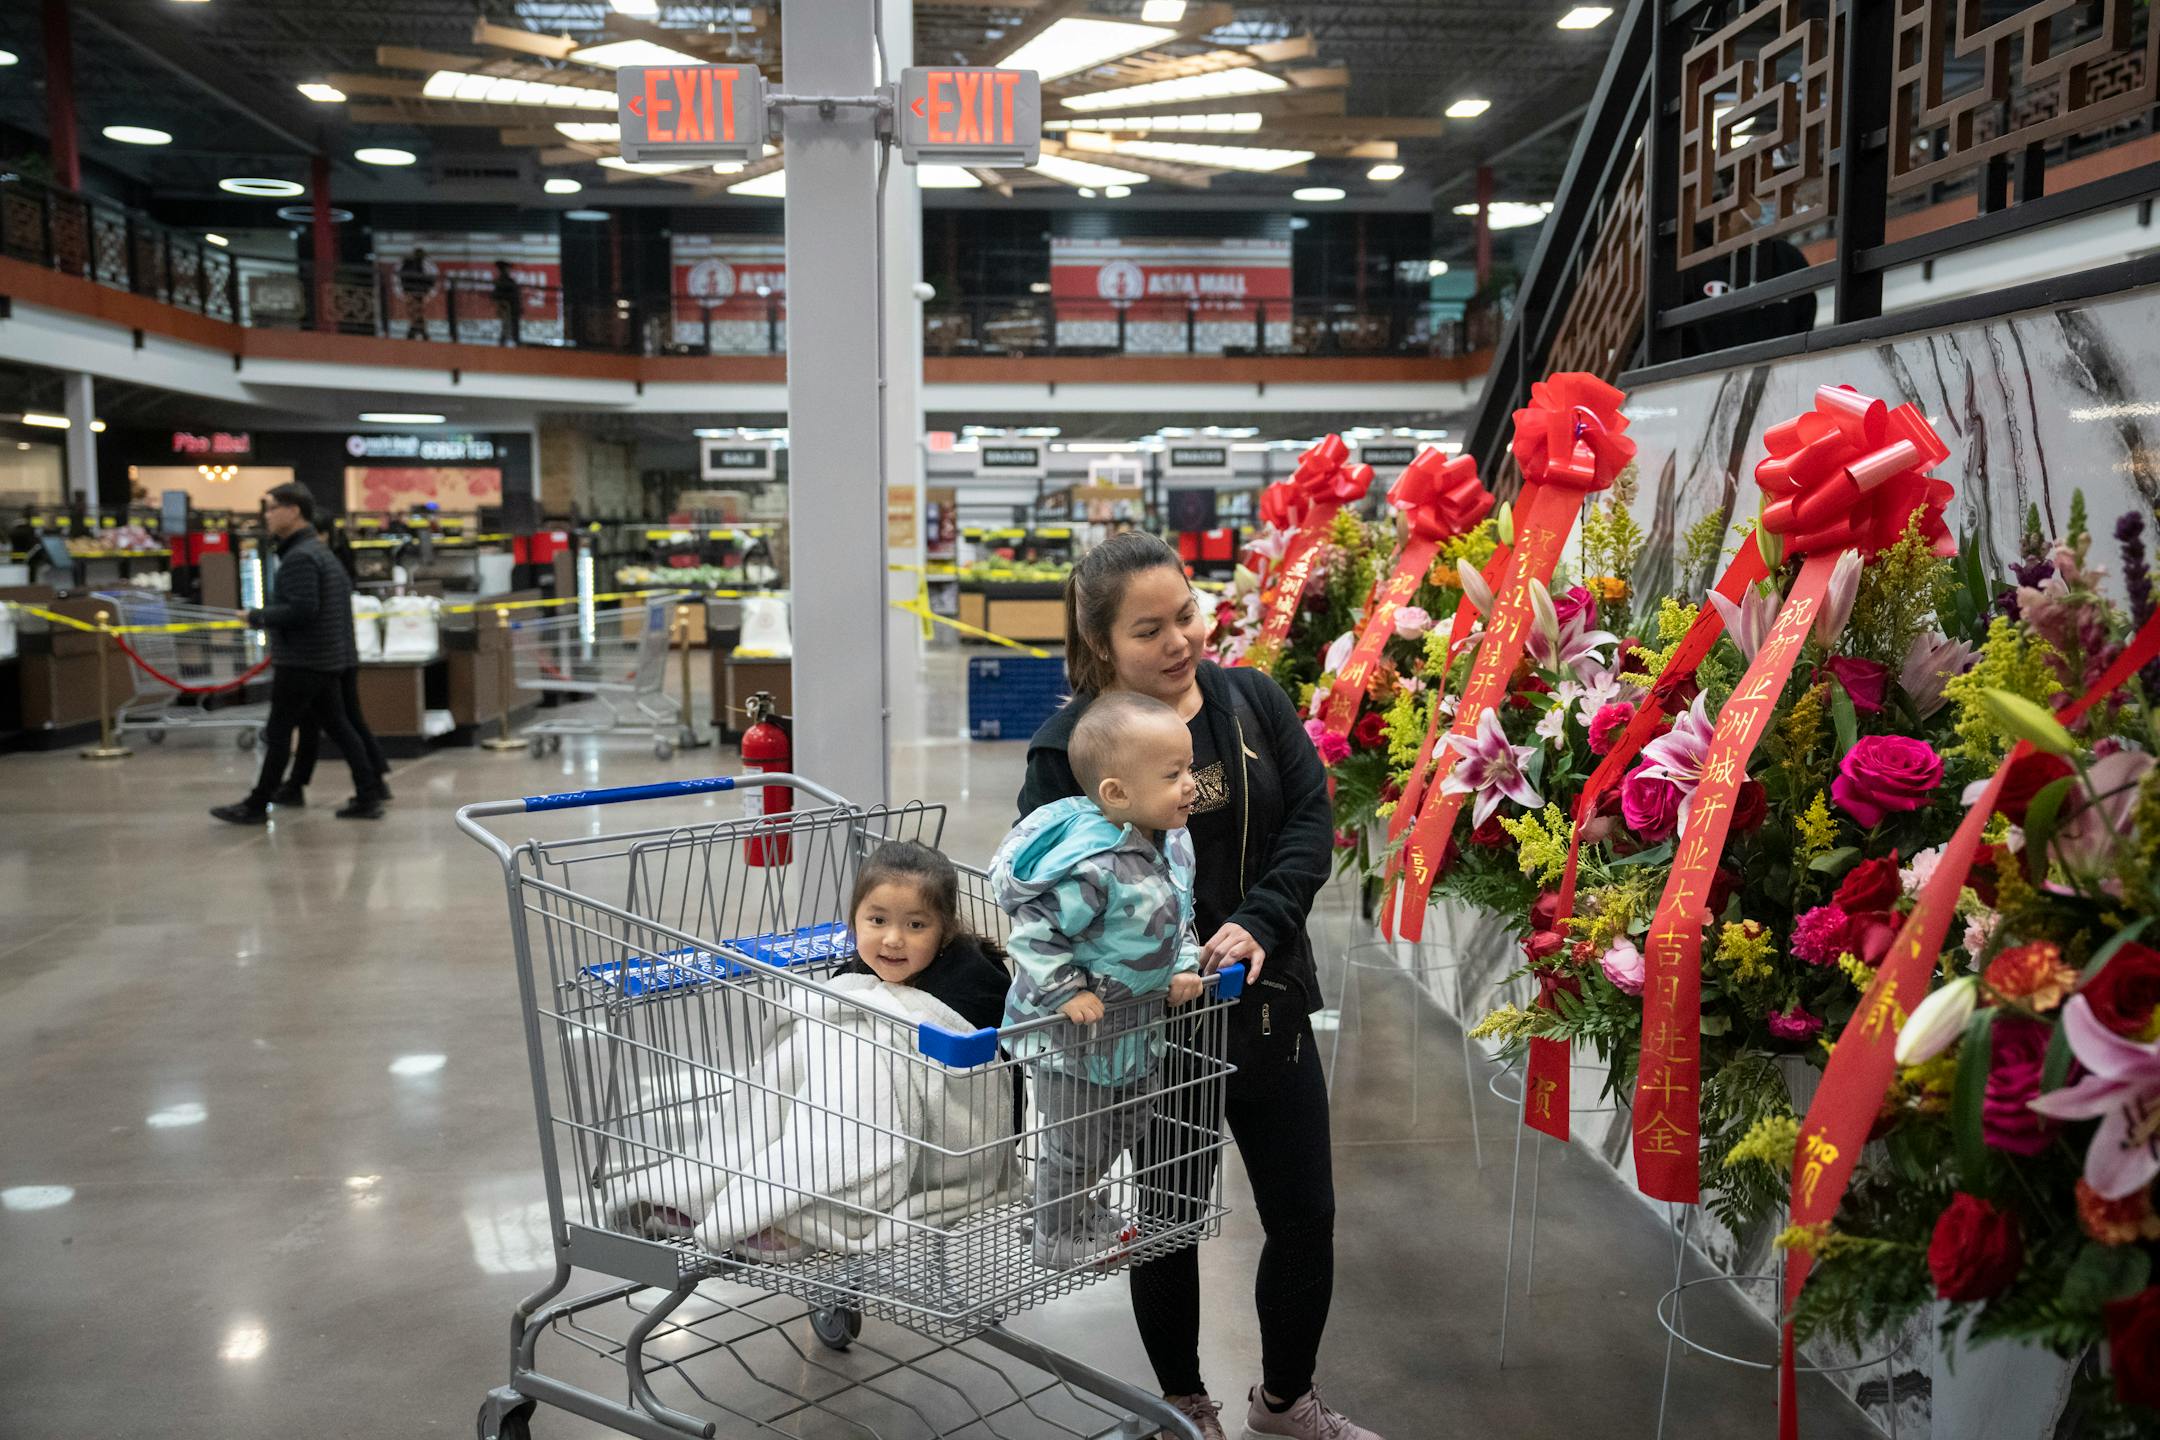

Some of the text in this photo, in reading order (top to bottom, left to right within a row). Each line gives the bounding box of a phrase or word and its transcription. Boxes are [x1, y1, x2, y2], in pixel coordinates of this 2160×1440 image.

[644, 69, 738, 143] EXIT
[927, 72, 1019, 144] EXIT
[1148, 273, 1245, 294] ASIA MALL
[986, 451, 1036, 464] SNACKS
[1174, 451, 1223, 464] SNACKS
